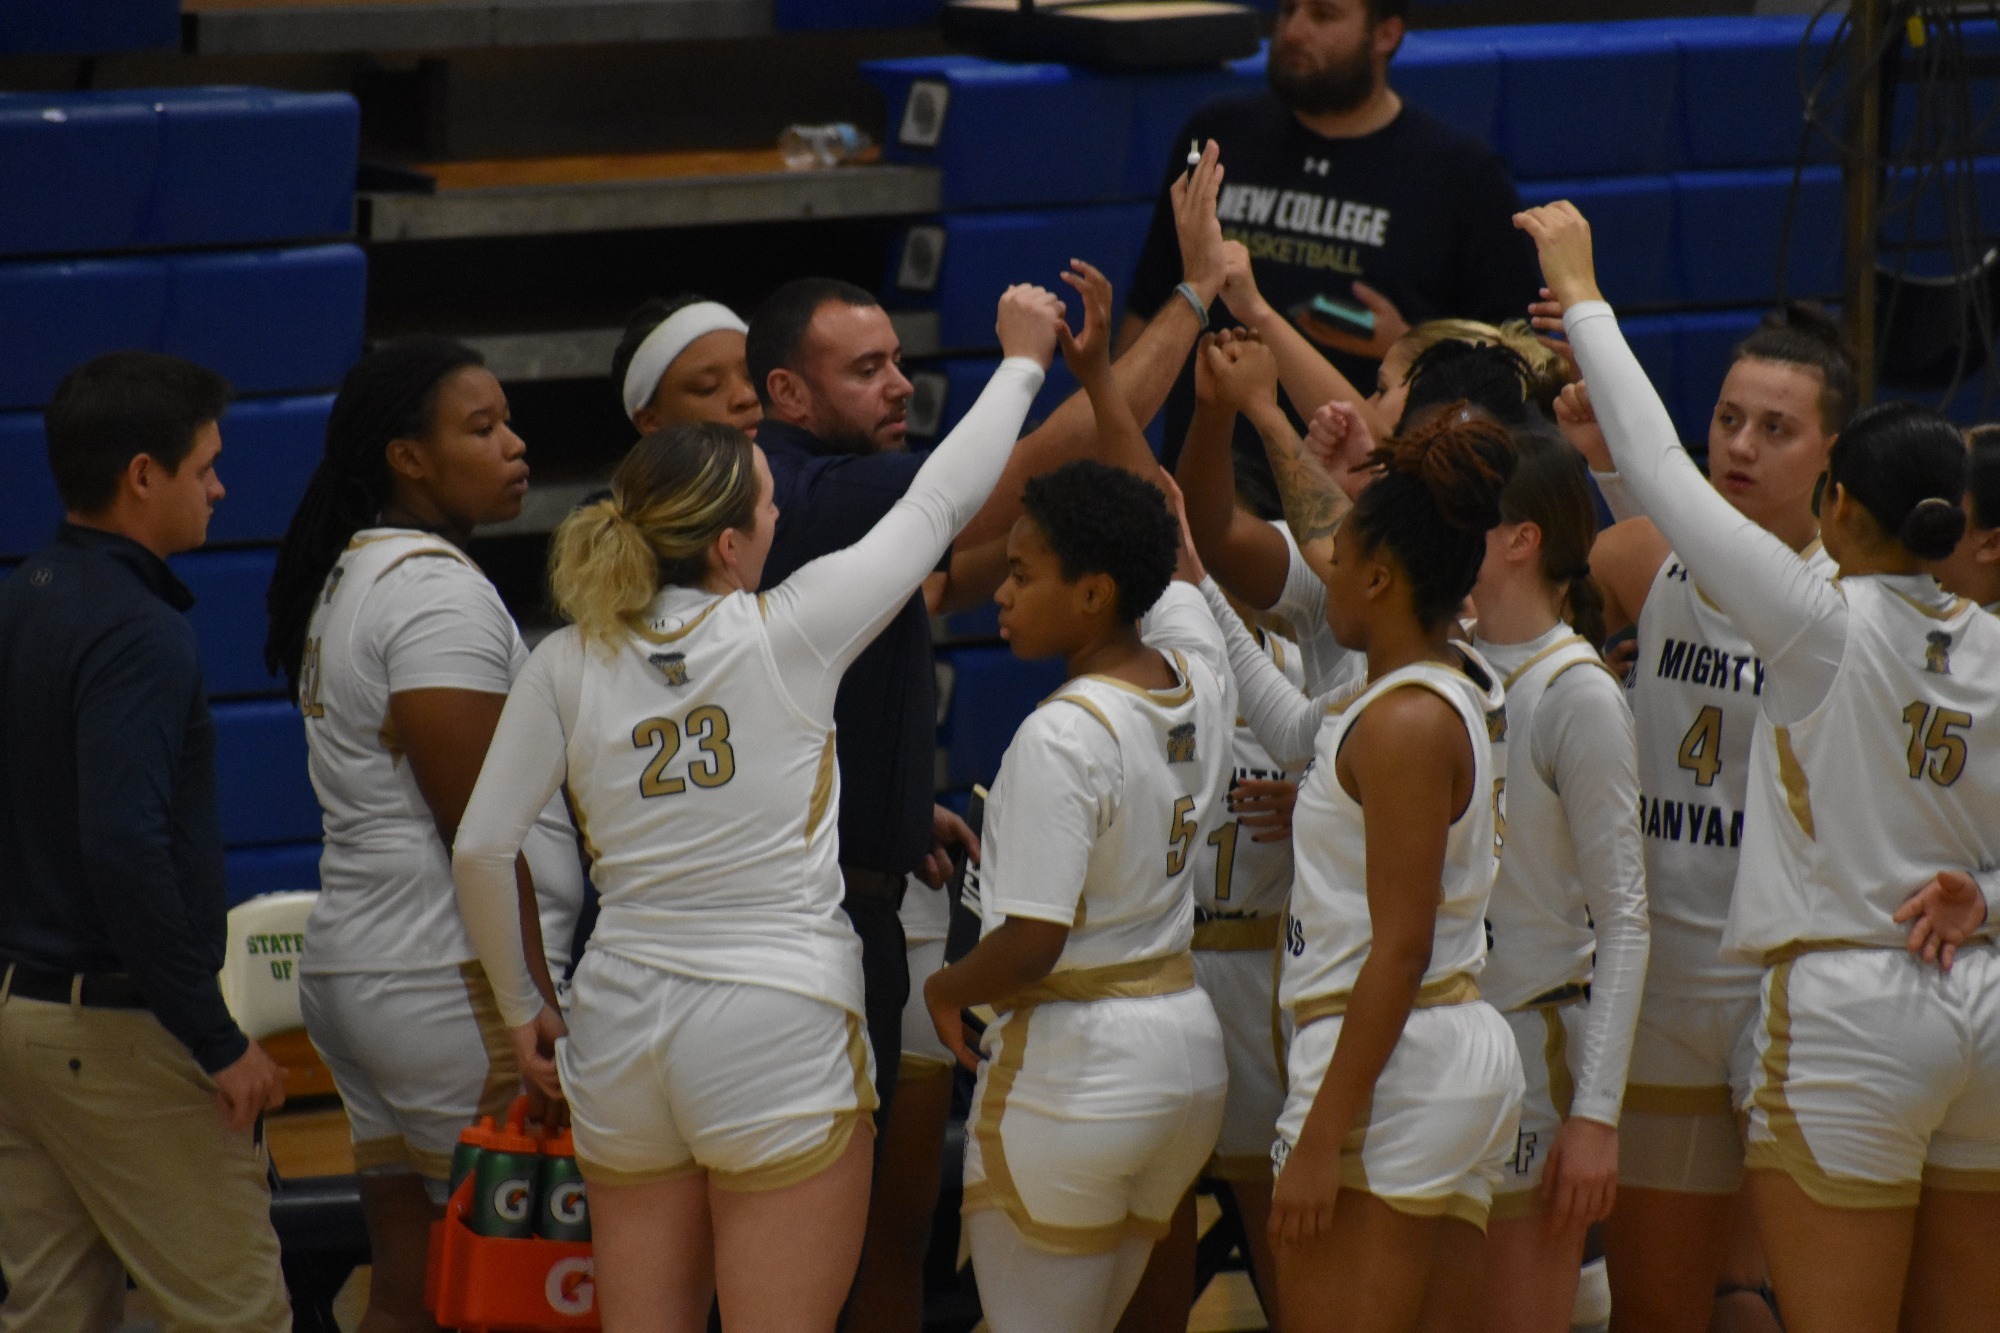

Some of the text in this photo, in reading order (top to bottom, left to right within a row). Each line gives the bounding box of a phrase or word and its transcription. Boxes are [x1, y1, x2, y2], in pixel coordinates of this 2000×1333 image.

[1217, 183, 1391, 247] NEW COLLEGE
[1657, 638, 1765, 696] MIGHTY
[632, 704, 735, 798] 23
[1678, 705, 1722, 787] 4
[1902, 699, 1972, 787] 15
[1166, 794, 1198, 878] 5
[1207, 820, 1239, 901] 1
[271, 960, 292, 980] OF
[494, 1179, 530, 1220] G
[550, 1182, 586, 1224] G
[546, 1256, 594, 1316] G
